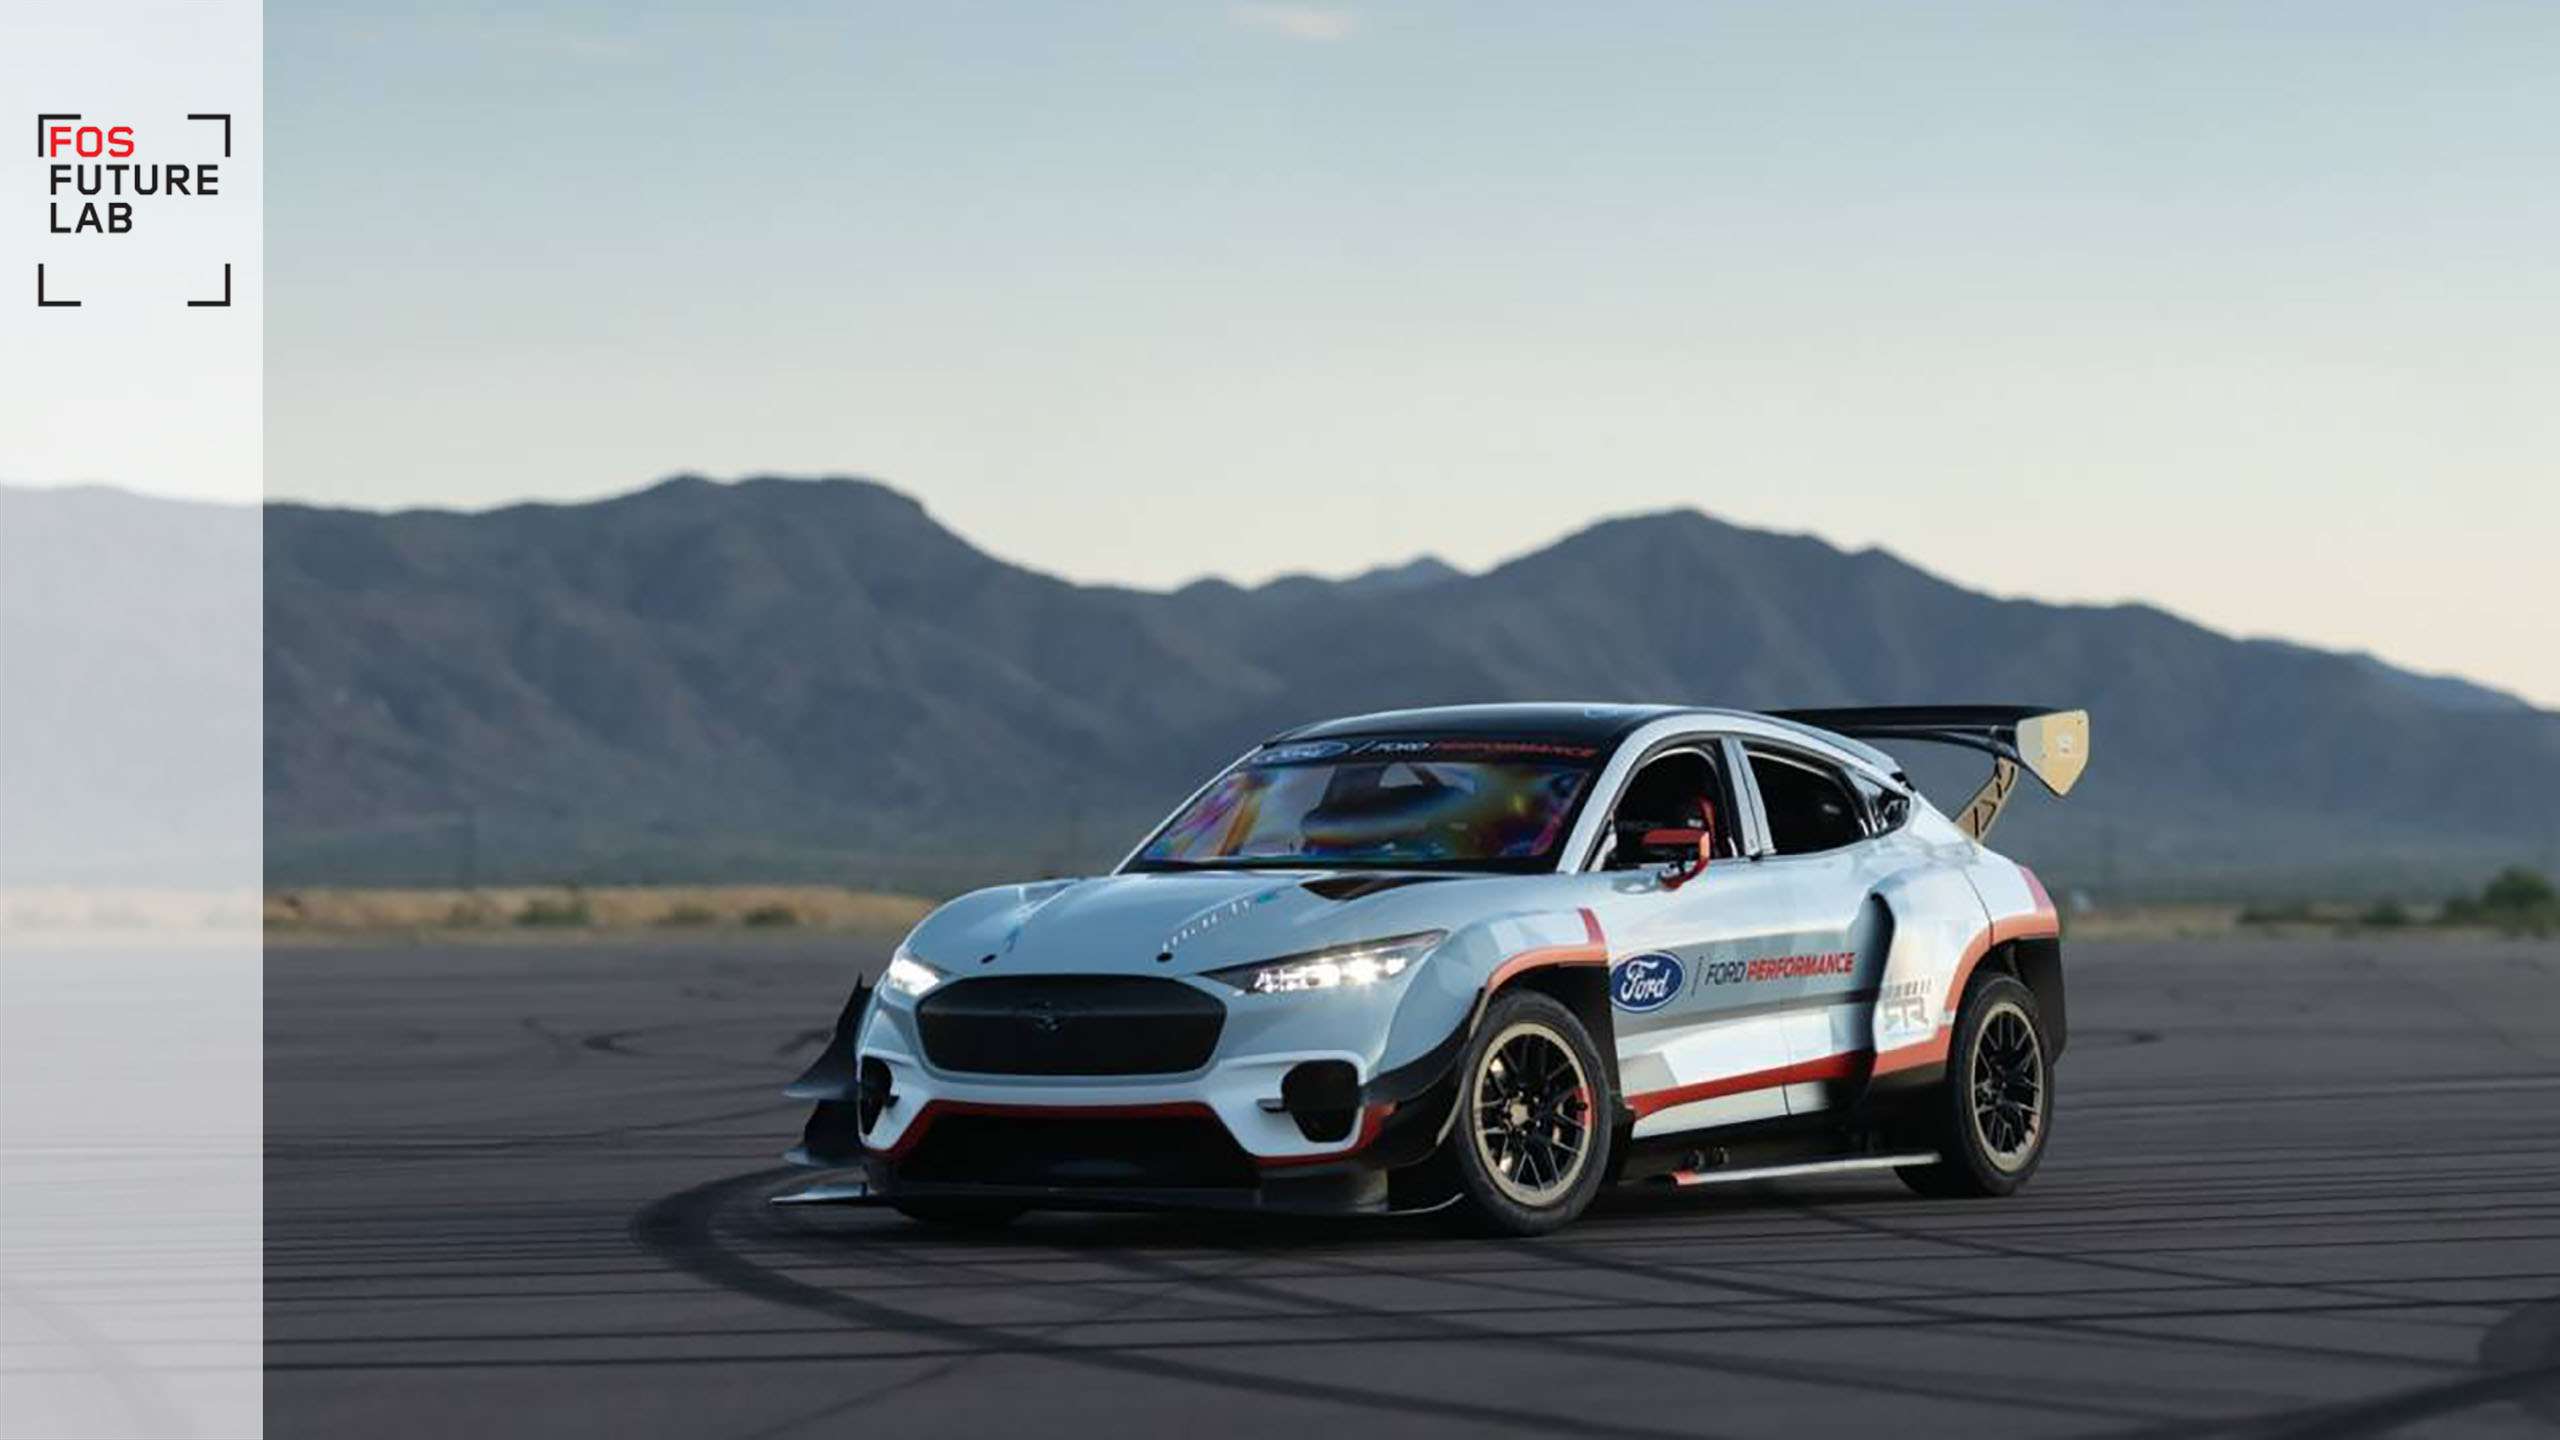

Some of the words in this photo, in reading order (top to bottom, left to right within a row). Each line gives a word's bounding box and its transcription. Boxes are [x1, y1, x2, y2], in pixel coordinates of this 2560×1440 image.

[1620, 960, 1671, 1001] Ford
[1704, 961, 1746, 986] FORD
[1747, 951, 1856, 982] PERFORMANCE
